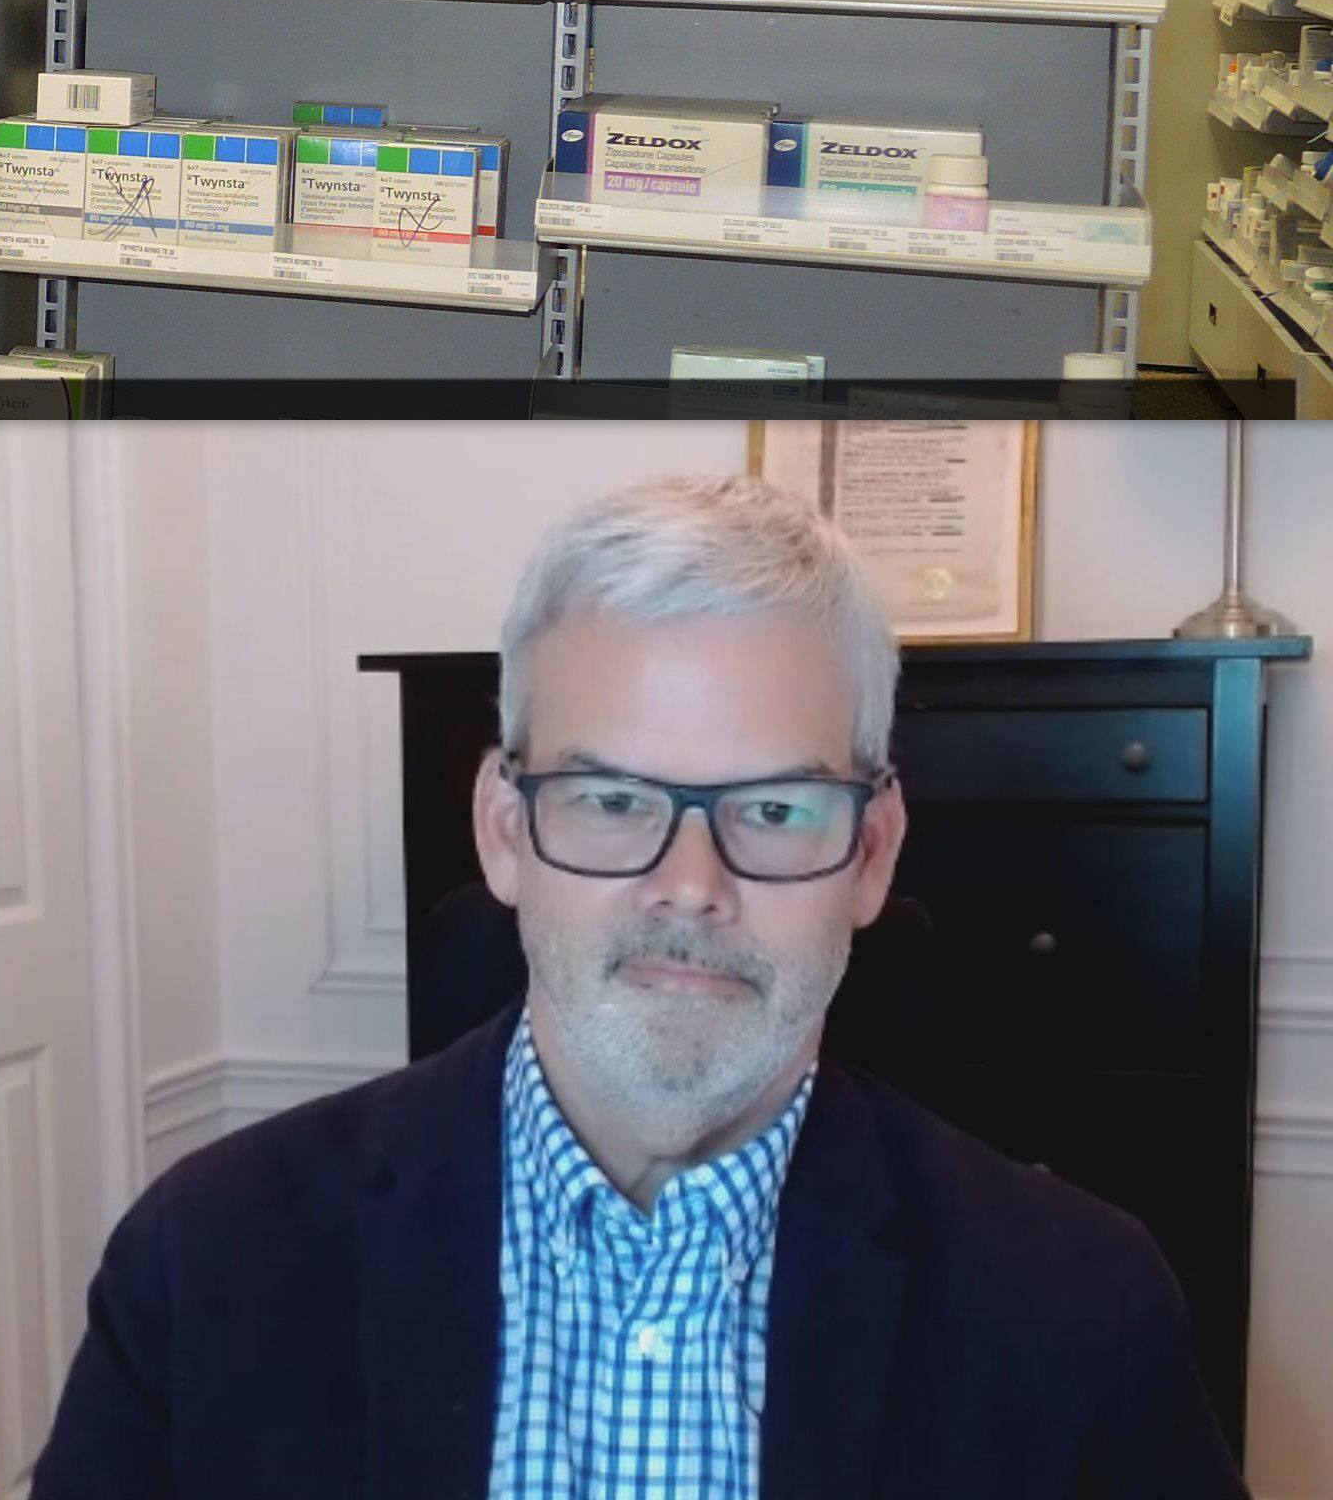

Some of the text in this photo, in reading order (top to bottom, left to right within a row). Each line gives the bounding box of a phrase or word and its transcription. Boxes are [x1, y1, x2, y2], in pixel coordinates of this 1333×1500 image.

[606, 132, 702, 151] ZELDOX
[820, 141, 919, 159] ZELDOX
[4, 162, 54, 177] Twynsta
[96, 168, 148, 183] Twynsta
[192, 174, 245, 190] Twynsta
[307, 177, 360, 192] Twynsta
[606, 175, 622, 188] 20
[386, 187, 441, 203] Twynsta
